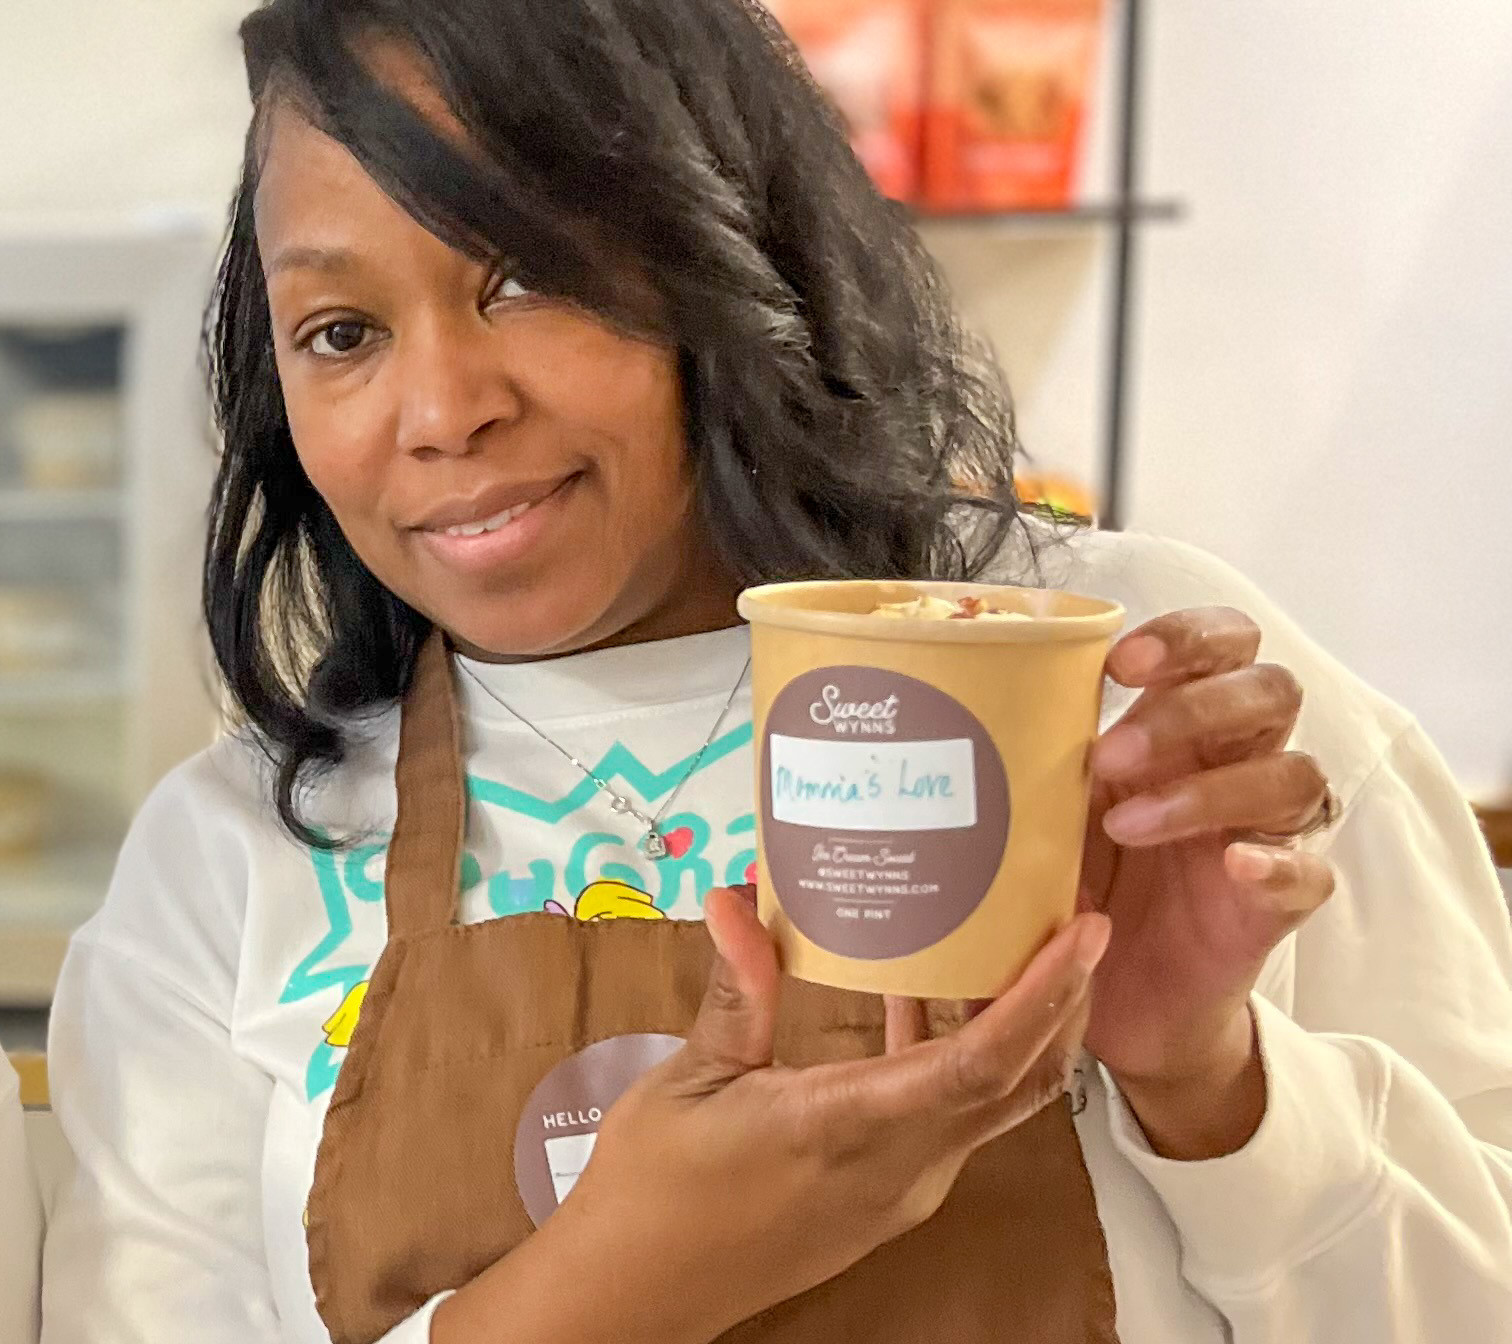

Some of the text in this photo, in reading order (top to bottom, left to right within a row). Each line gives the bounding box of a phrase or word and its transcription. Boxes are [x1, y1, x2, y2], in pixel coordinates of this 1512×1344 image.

[809, 685, 899, 725] Sweet
[833, 719, 896, 735] WYNNS
[898, 759, 954, 800] Love
[543, 1107, 602, 1129] HELLO
